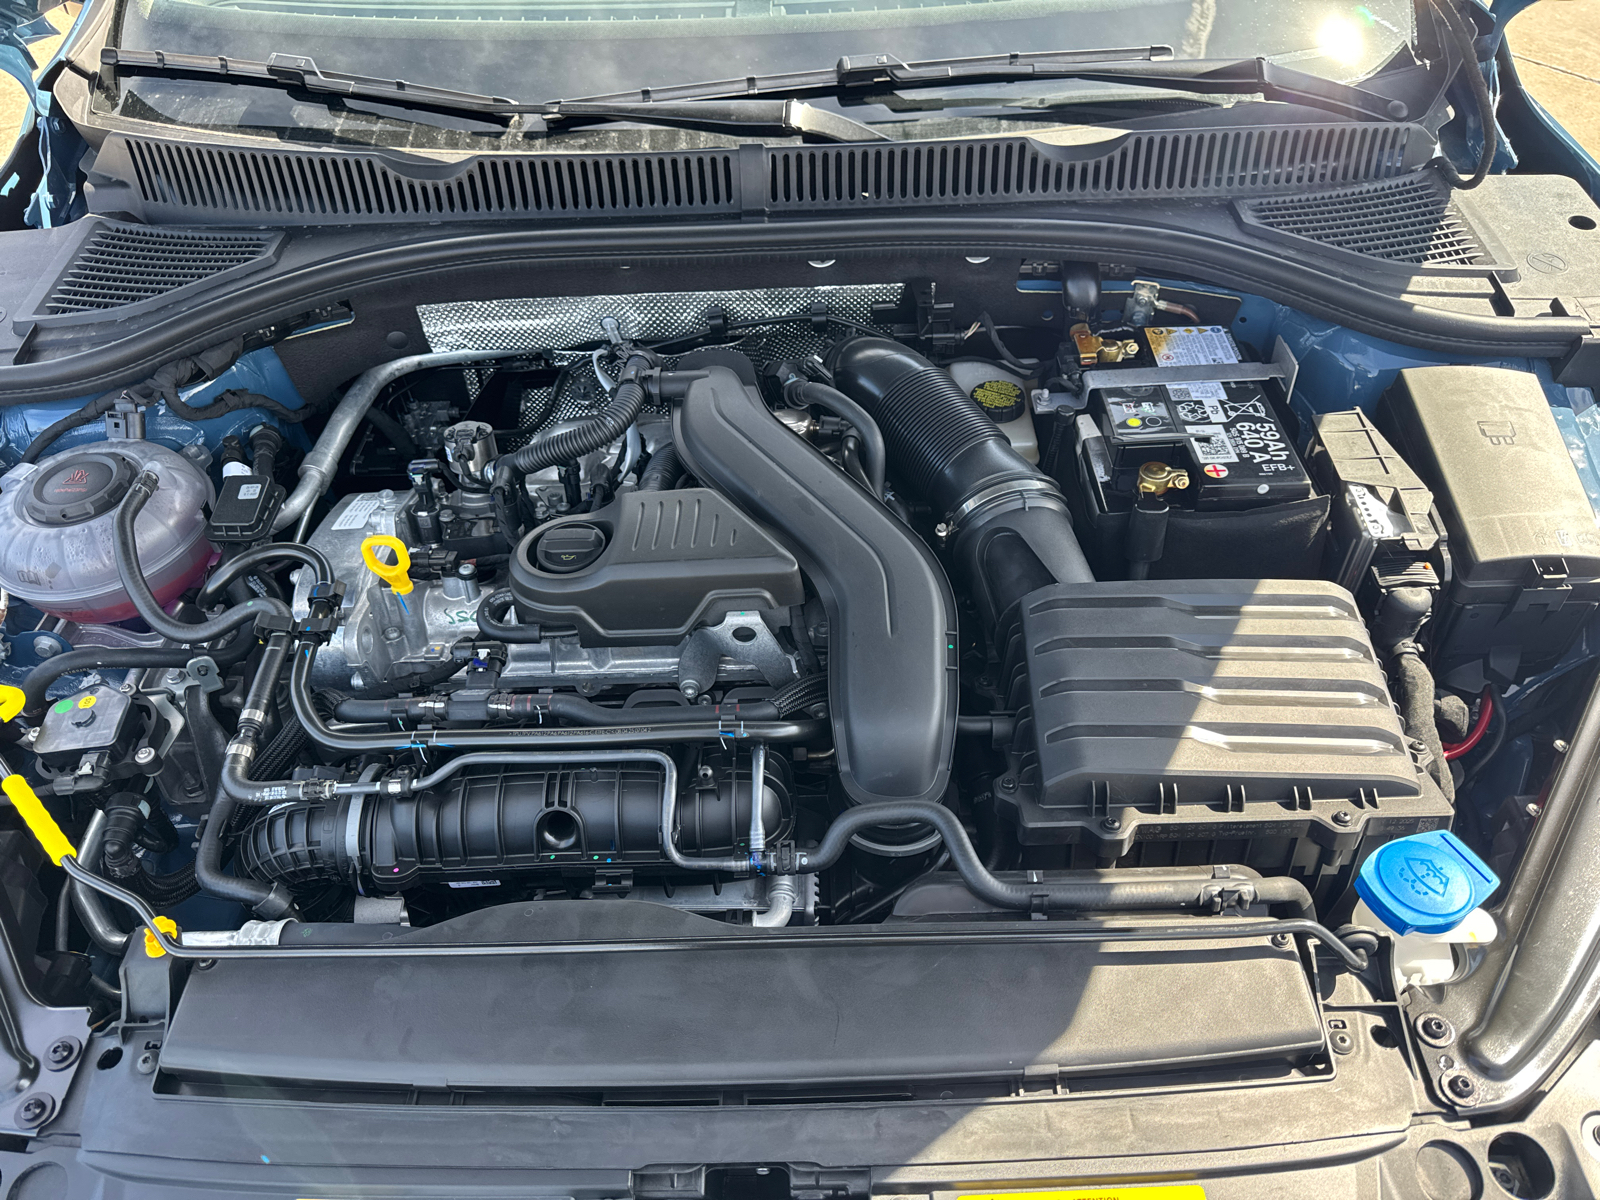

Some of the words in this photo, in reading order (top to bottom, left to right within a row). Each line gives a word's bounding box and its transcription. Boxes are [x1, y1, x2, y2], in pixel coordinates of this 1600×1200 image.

[1208, 405, 1220, 415] Pb
[1236, 422, 1264, 448] 640
[1256, 423, 1289, 460] 59Ah
[1249, 452, 1271, 463] A
[1262, 464, 1295, 472] EFB+
